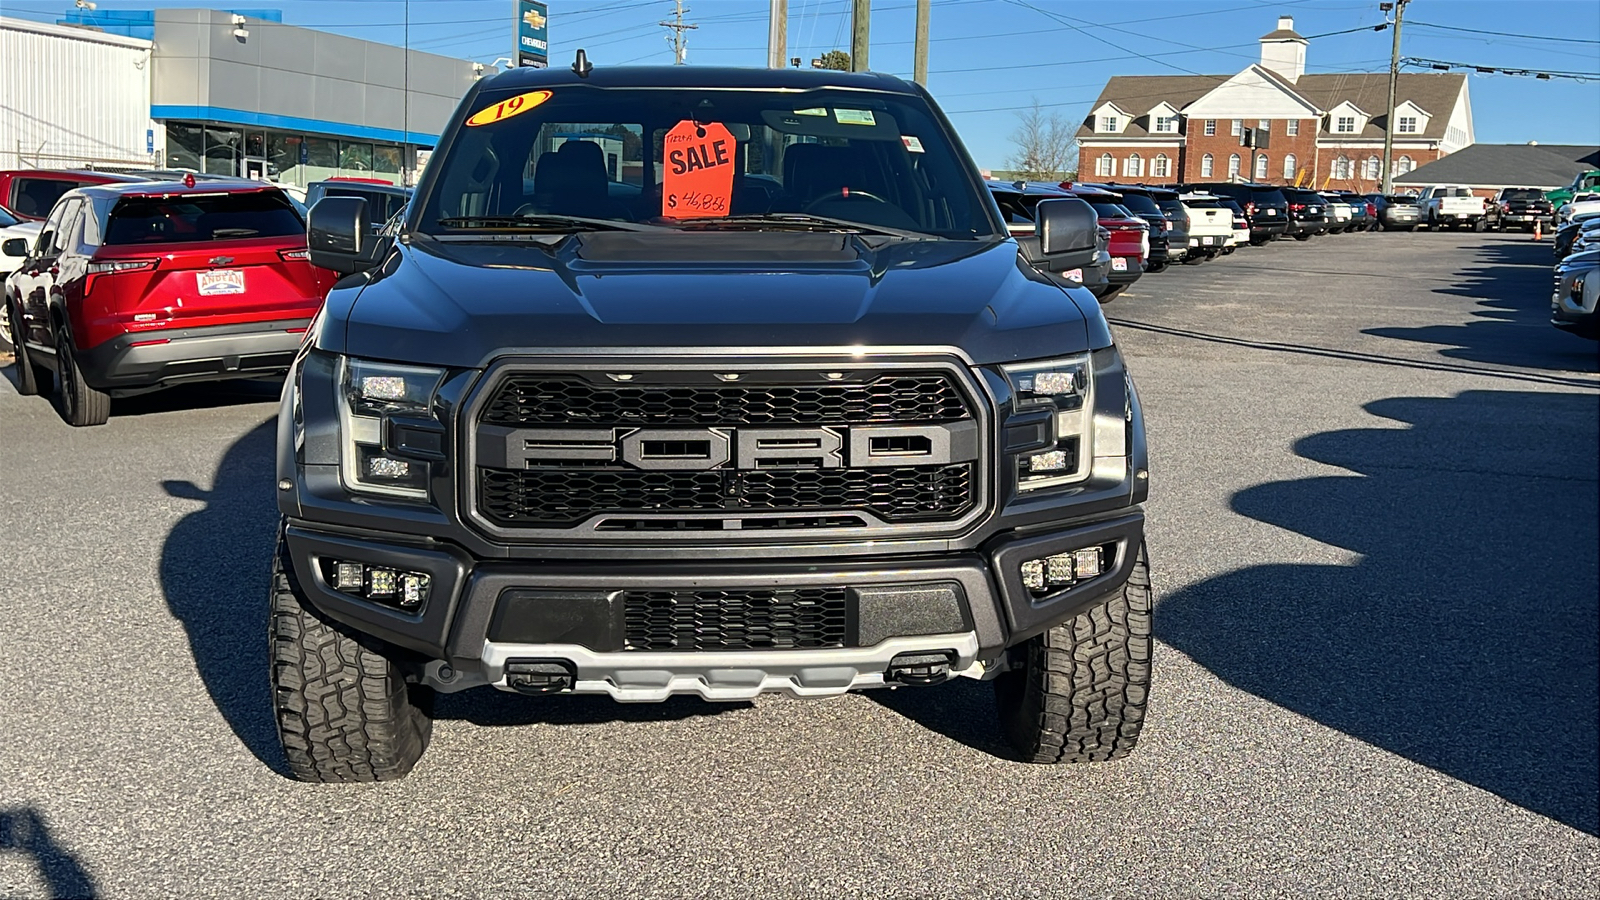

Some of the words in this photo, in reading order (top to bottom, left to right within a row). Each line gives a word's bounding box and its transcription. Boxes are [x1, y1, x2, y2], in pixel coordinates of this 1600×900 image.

[494, 96, 525, 120] 19
[669, 139, 730, 175] SALE
[667, 193, 677, 209] $
[682, 191, 725, 211] 46,856
[202, 272, 242, 288] ANDEAN
[505, 426, 950, 470] FORD
